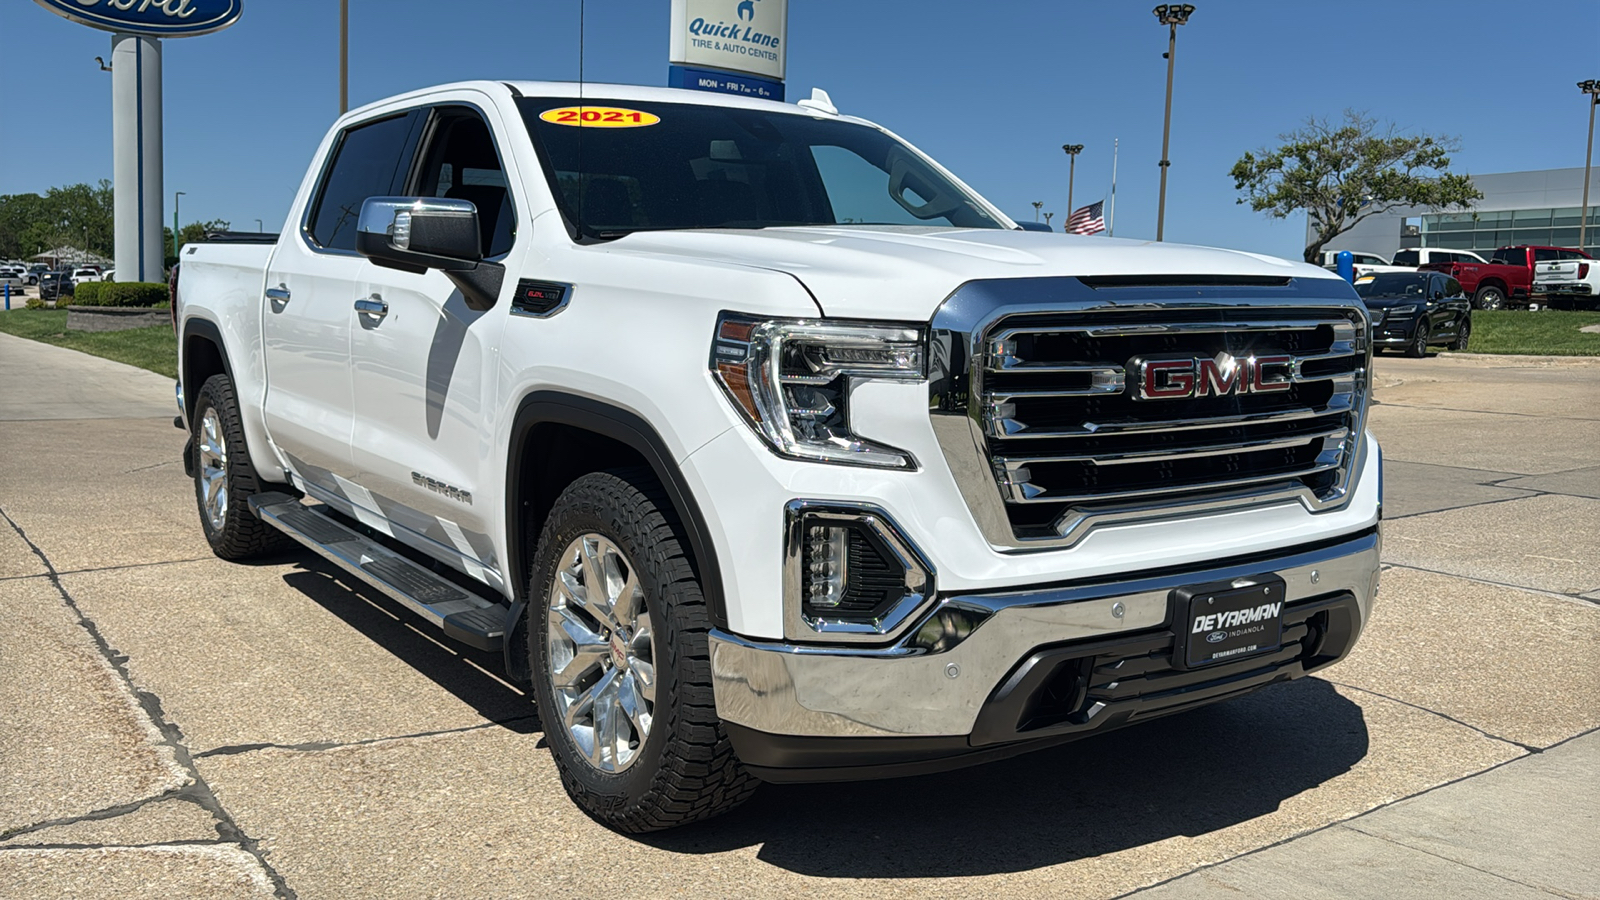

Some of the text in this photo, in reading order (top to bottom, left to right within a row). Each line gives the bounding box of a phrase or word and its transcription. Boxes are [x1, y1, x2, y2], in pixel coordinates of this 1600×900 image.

[689, 18, 780, 48] Quick Lane
[691, 38, 778, 61] TIRE & AUTO CENTER
[699, 79, 718, 88] MON
[727, 82, 739, 91] FRI
[556, 111, 641, 123] 2021
[1140, 353, 1292, 400] GMC
[411, 471, 473, 506] SIERRA
[1191, 602, 1281, 634] DEYARMAN
[1229, 625, 1265, 638] INDIANOLA
[1212, 645, 1257, 659] DEYARMANFORD.COM
